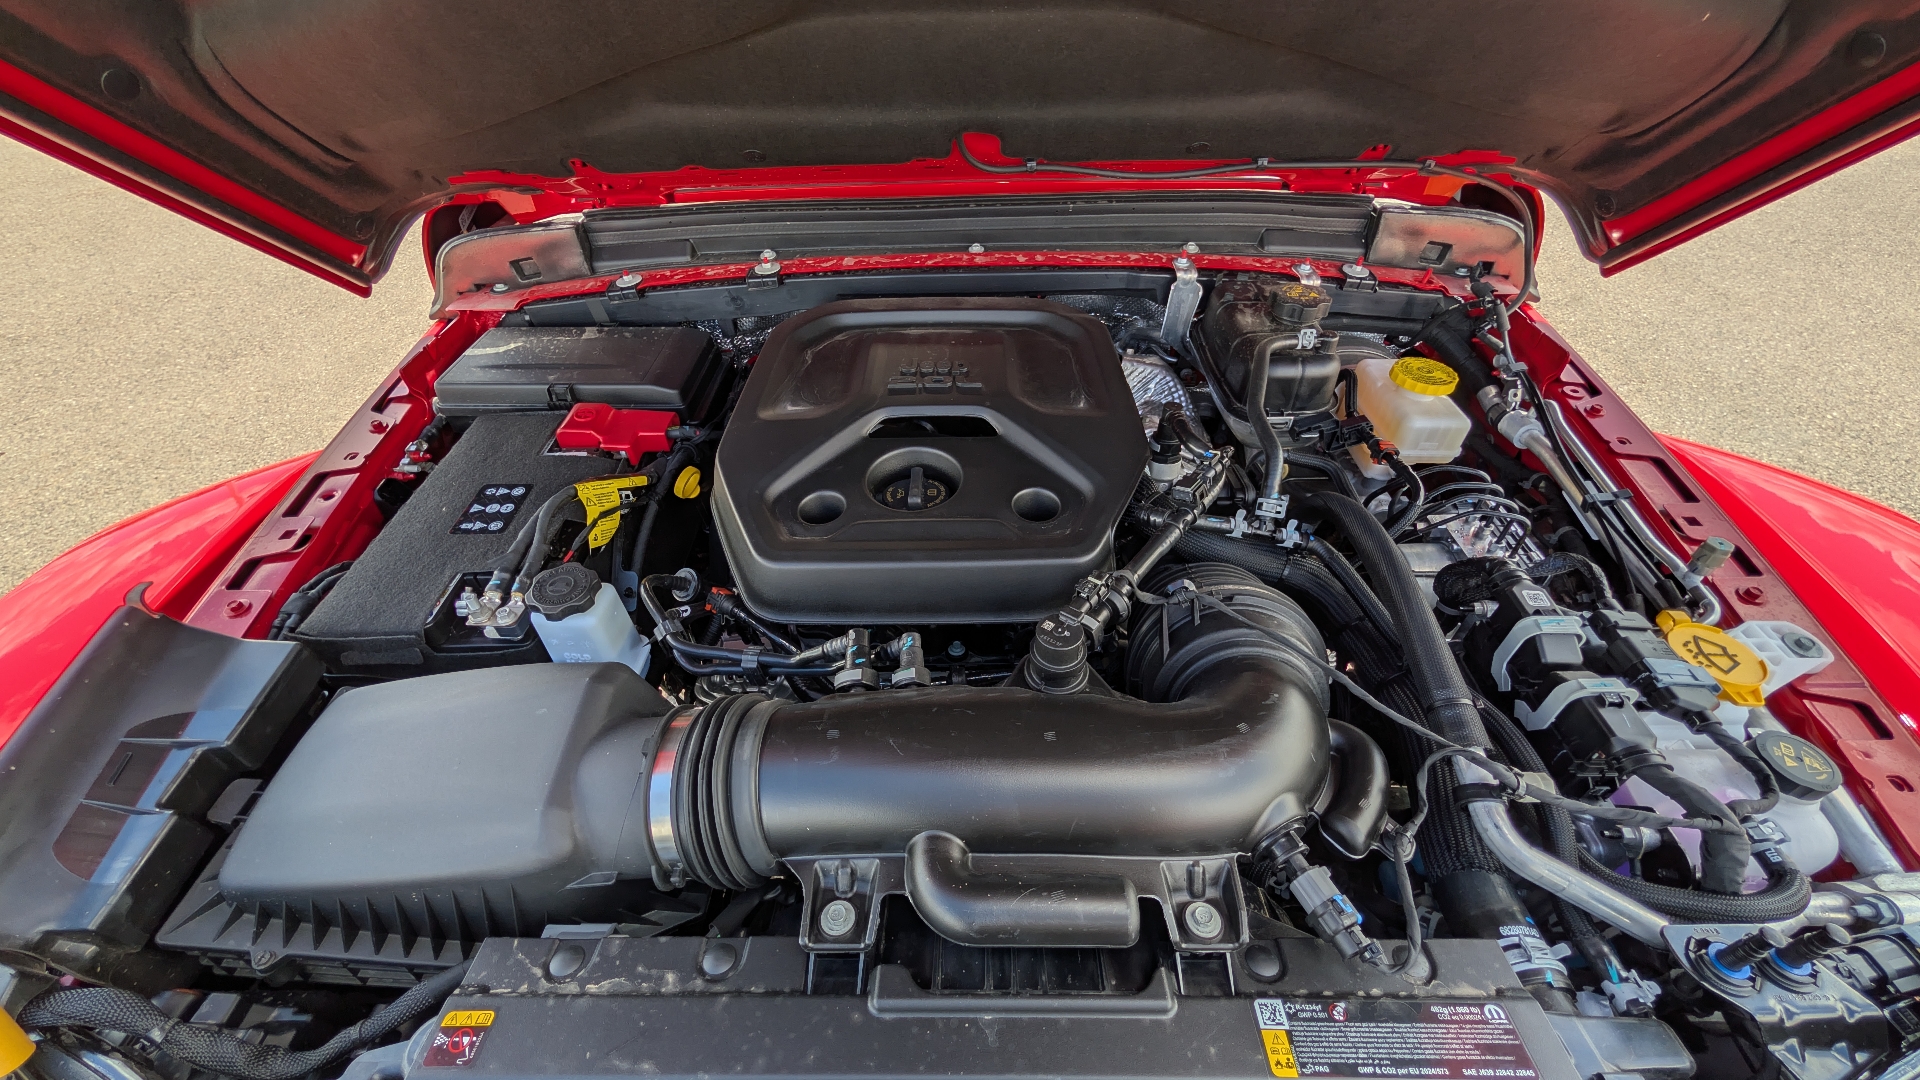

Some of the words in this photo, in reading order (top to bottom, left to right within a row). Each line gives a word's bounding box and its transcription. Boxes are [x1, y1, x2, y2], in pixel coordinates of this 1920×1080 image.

[899, 357, 969, 376] Jeep
[563, 652, 591, 660] COLD
[1315, 1065, 1329, 1073] PAG
[1358, 1066, 1373, 1074] GWP
[1375, 1066, 1381, 1074] &
[1398, 1068, 1408, 1076] per
[1409, 1067, 1419, 1075] EU
[1462, 1068, 1477, 1076] SAE
